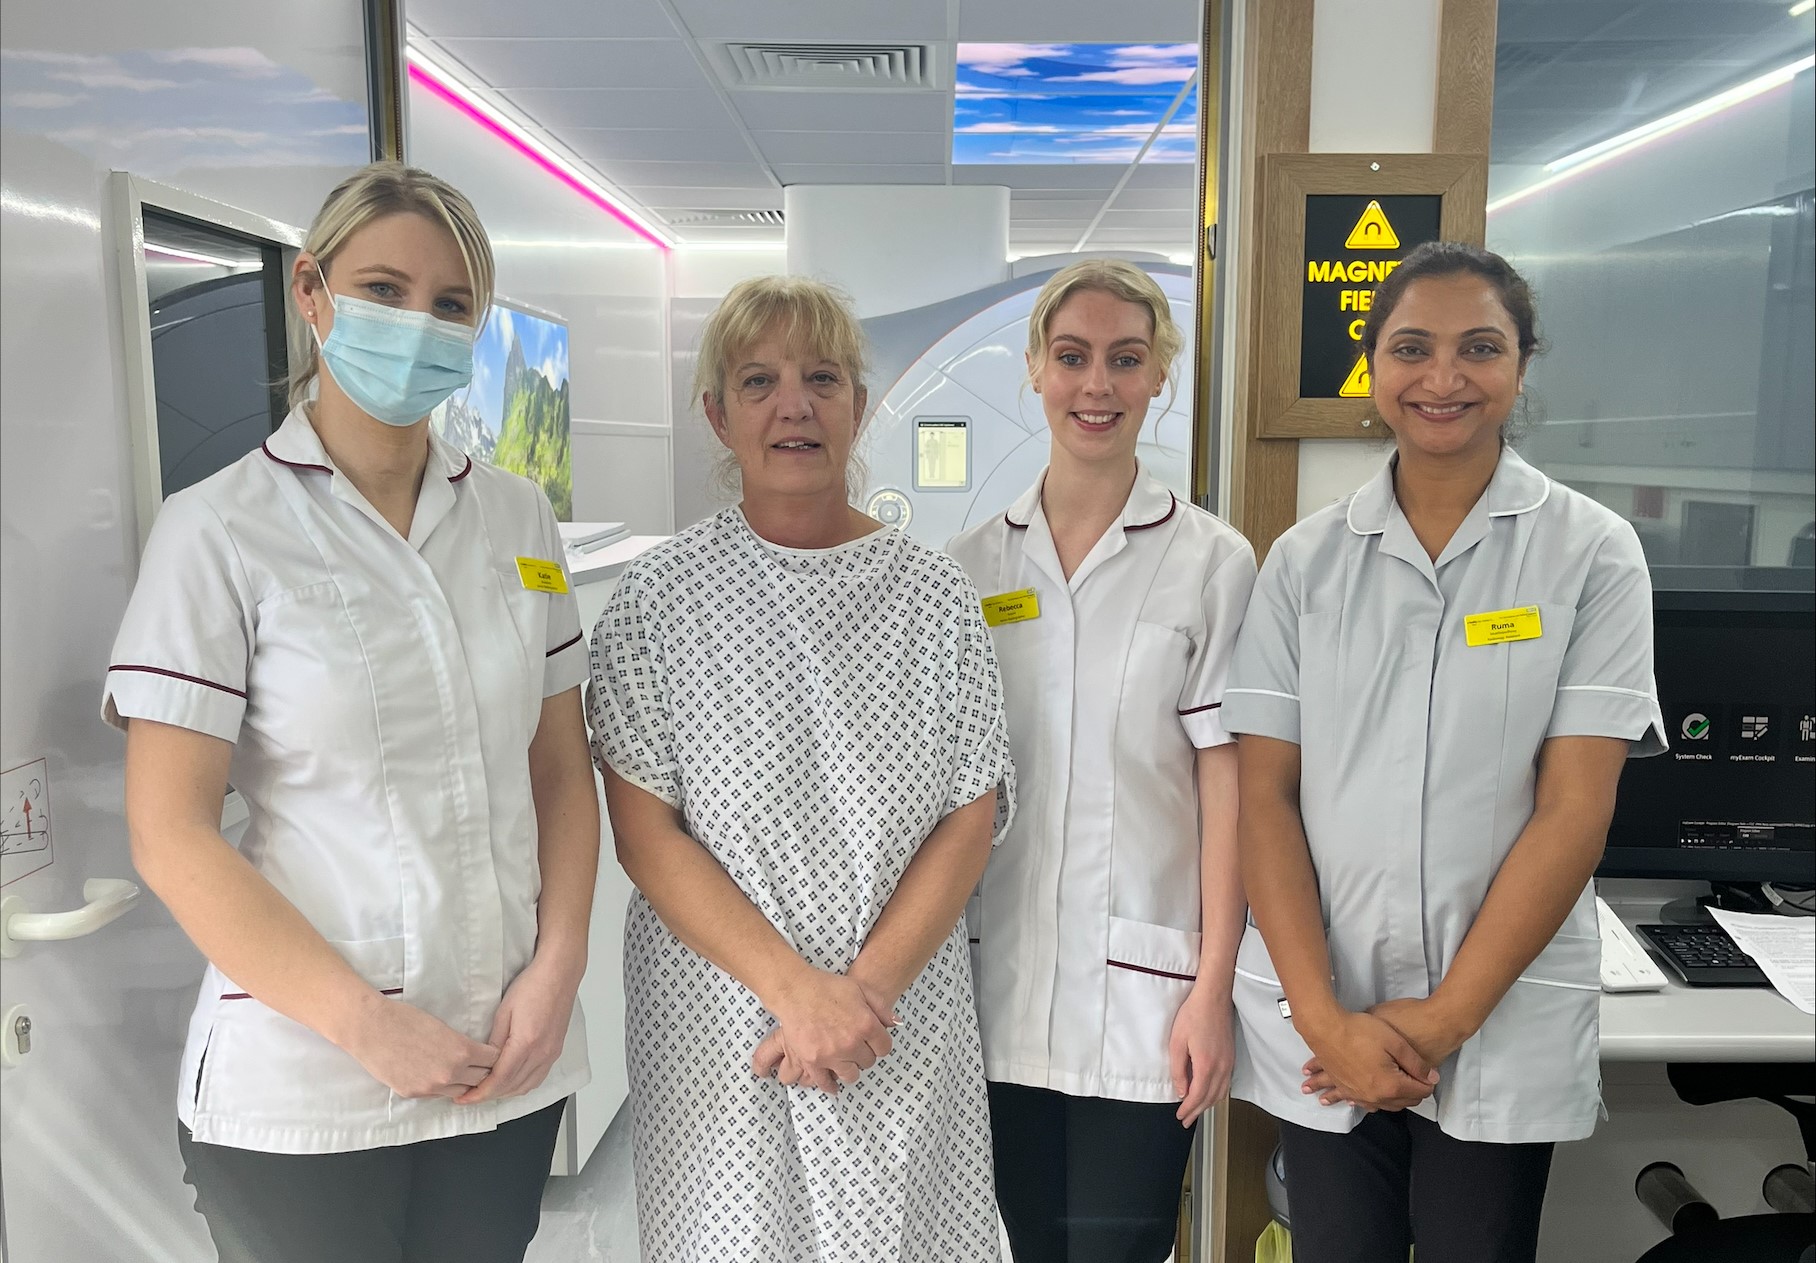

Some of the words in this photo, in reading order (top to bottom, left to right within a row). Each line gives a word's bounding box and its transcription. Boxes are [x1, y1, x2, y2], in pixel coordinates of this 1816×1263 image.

[1308, 260, 1402, 283] MAGNE
[998, 603, 1023, 612] Rebecca
[1491, 622, 1515, 631] Ruma
[1730, 754, 1754, 762] myExam
